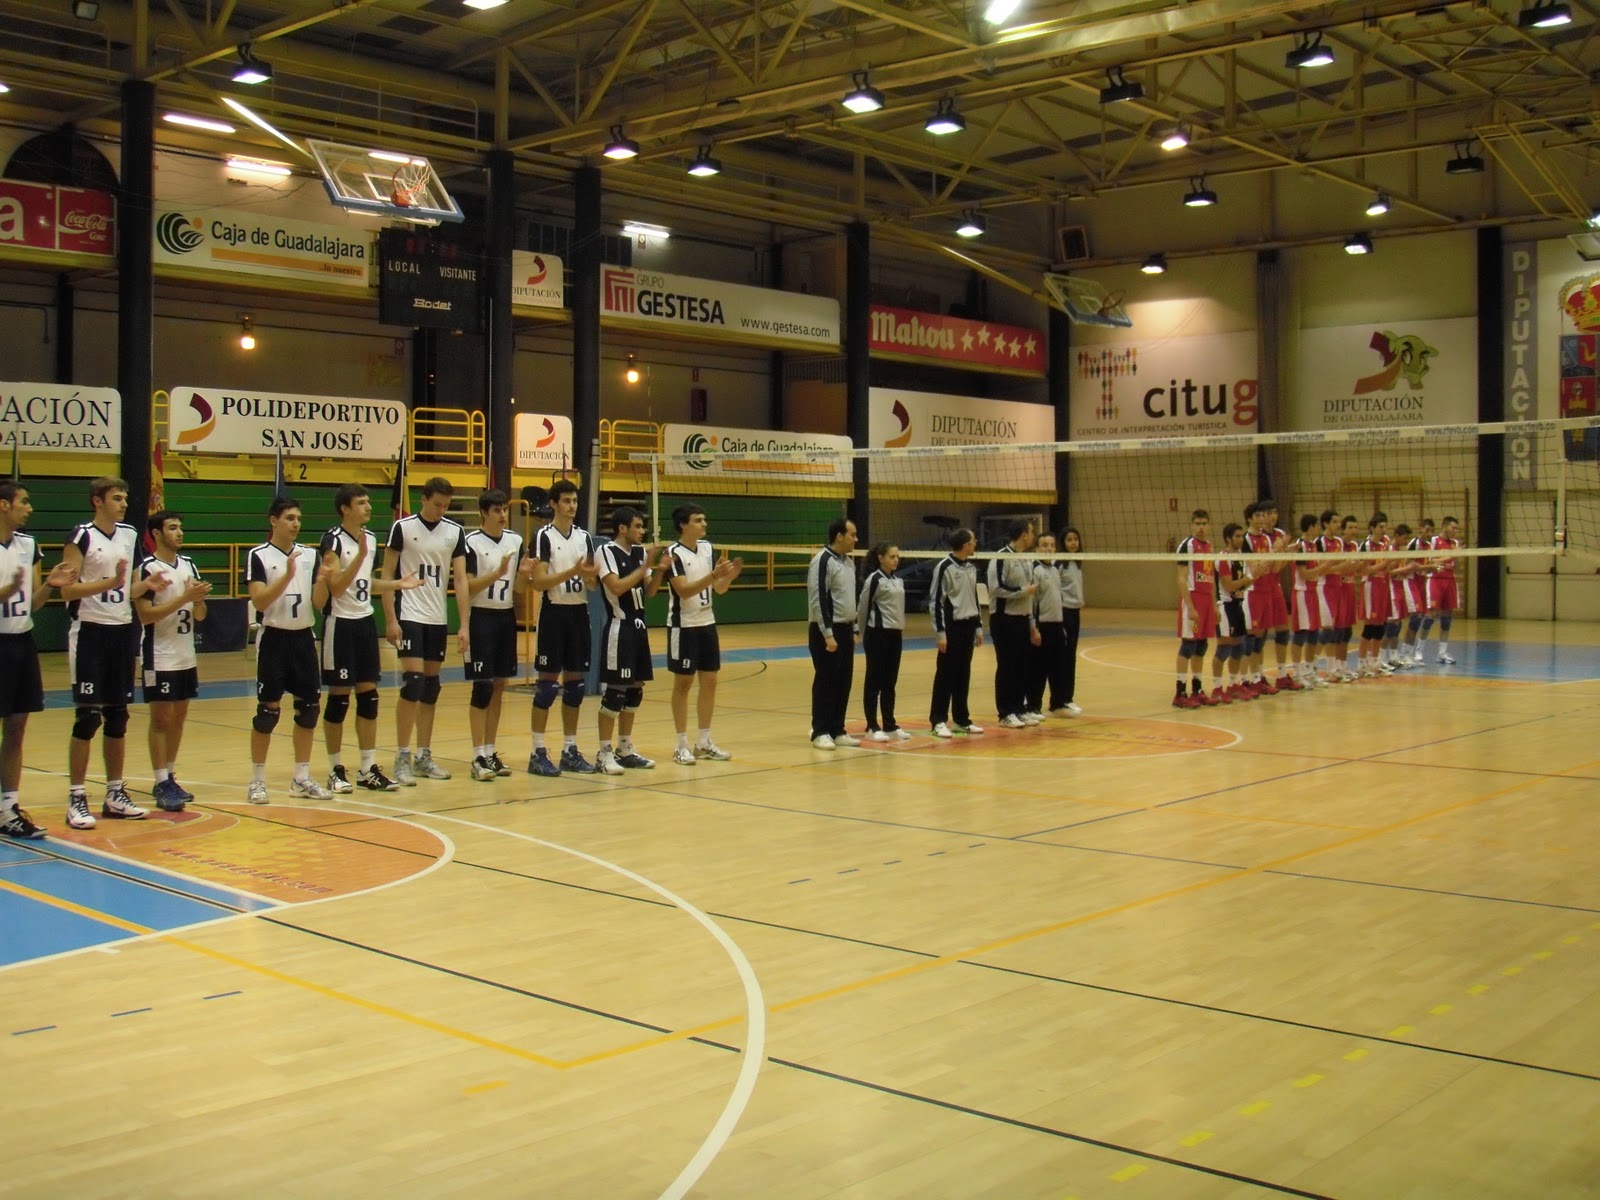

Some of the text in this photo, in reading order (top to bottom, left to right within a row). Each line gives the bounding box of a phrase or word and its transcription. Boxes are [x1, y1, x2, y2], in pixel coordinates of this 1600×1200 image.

[211, 220, 365, 260] Caja de Guadalajara
[388, 259, 477, 282] LOCAL VISITANTE
[636, 273, 665, 289] GRUPO
[637, 289, 725, 325] GESTESA
[740, 317, 830, 338] www.gestesa.com
[871, 311, 956, 350] Mahou
[0, 391, 113, 427] ACIÓN
[221, 396, 400, 425] POLIDEPORTIVO
[1143, 378, 1259, 426] citug
[1323, 393, 1424, 413] DIPUTACIÓN
[931, 415, 1017, 438] DIPUTACIÓN
[1323, 414, 1338, 423] DE
[0, 430, 112, 449] ALAJARA
[261, 428, 363, 451] SAN JOSÉ
[1077, 427, 1106, 436] CENTRO
[751, 439, 765, 453] de
[299, 463, 307, 480] 2
[418, 563, 441, 588] 14
[565, 575, 582, 593] 18
[355, 578, 369, 602] 8
[487, 578, 510, 601] 17
[285, 593, 302, 619] 7
[177, 609, 191, 634] 3
[474, 661, 484, 673] 17
[538, 655, 548, 666] 18
[682, 659, 691, 669] 9
[339, 668, 348, 680] 8
[620, 668, 631, 679] 10
[80, 681, 94, 694] 13
[160, 682, 170, 694] 3
